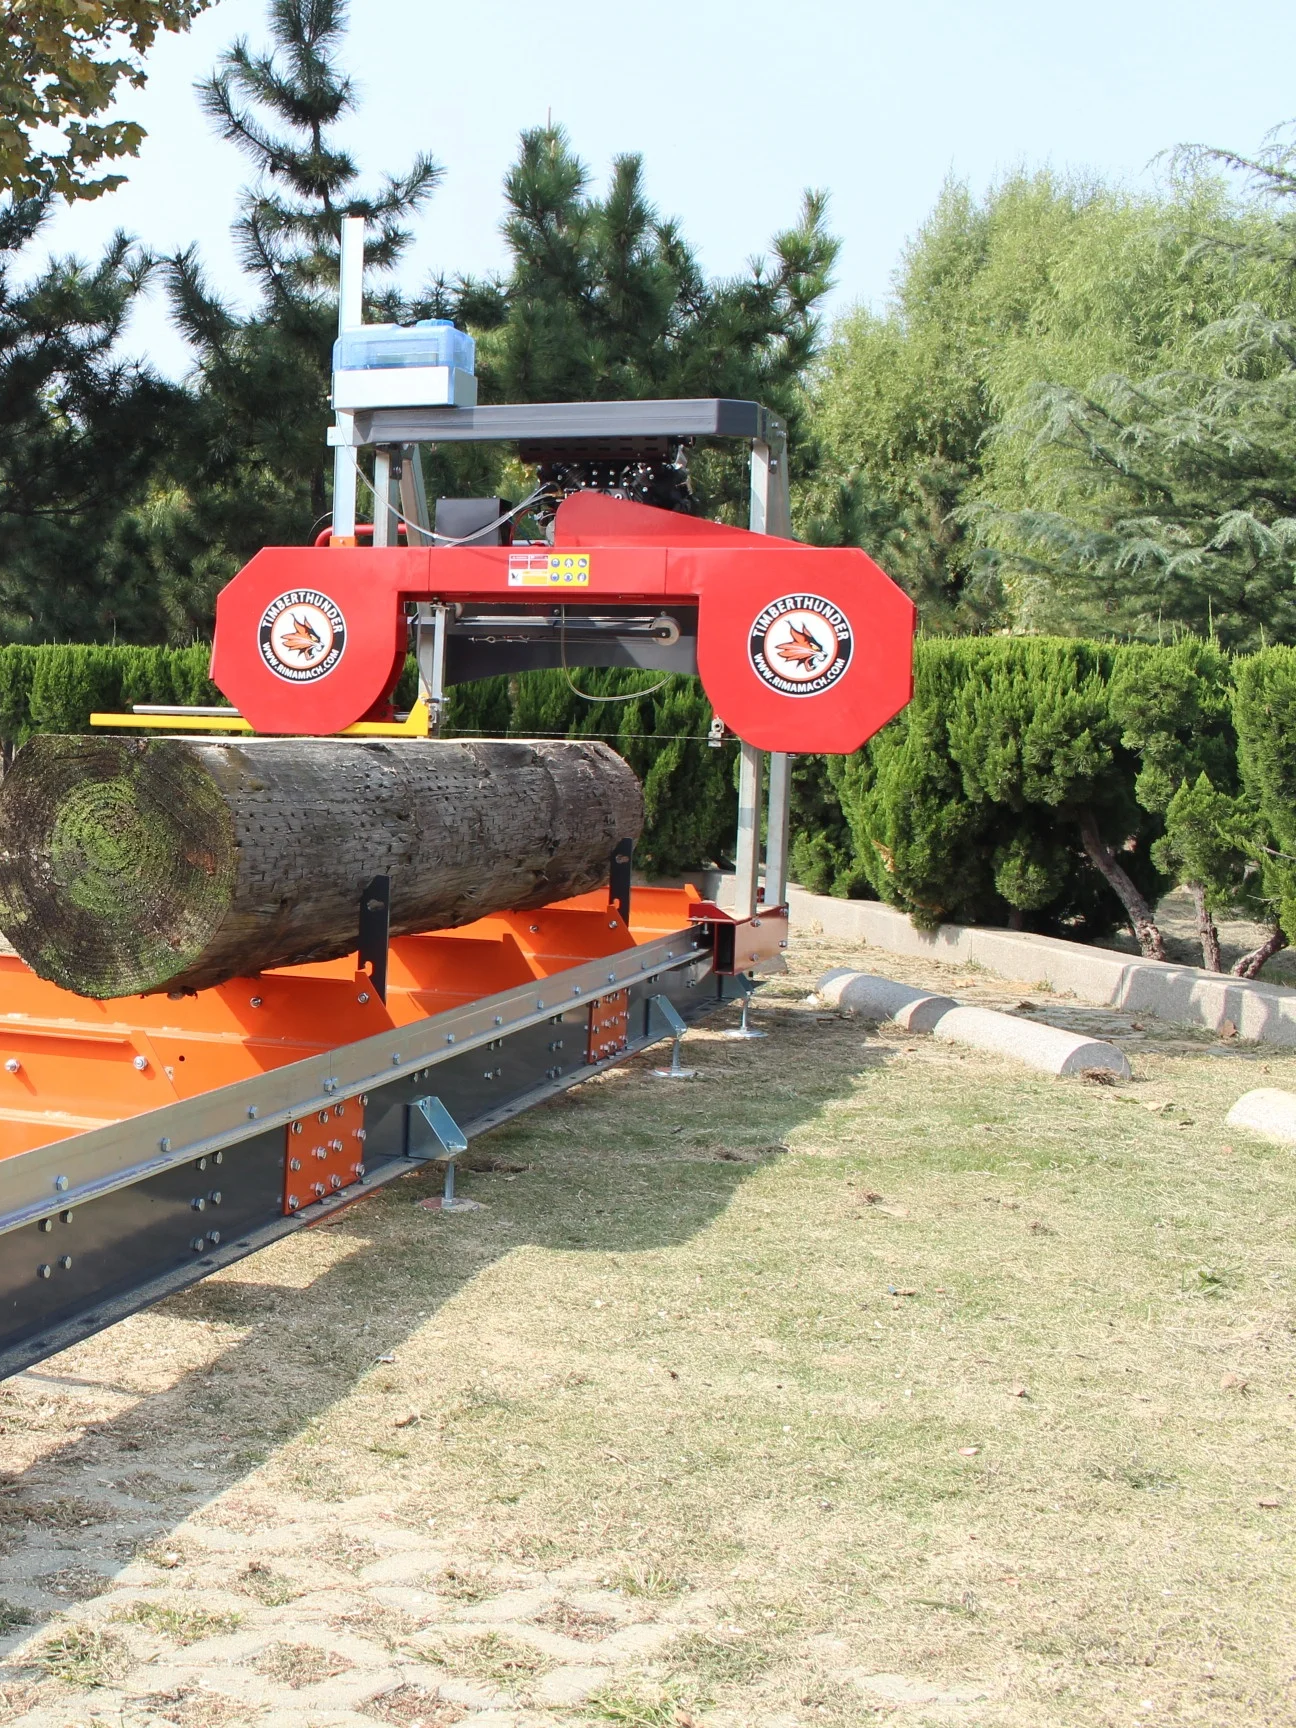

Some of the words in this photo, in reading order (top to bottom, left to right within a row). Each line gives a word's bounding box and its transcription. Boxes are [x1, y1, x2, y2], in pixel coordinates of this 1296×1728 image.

[262, 592, 343, 633] TIMBERTHUNDER
[753, 597, 849, 641] TIMBERTHUNDER
[262, 642, 339, 679] WWW.RIMAMACH.COM
[754, 652, 845, 693] WWW.RIMAMACH.COM
